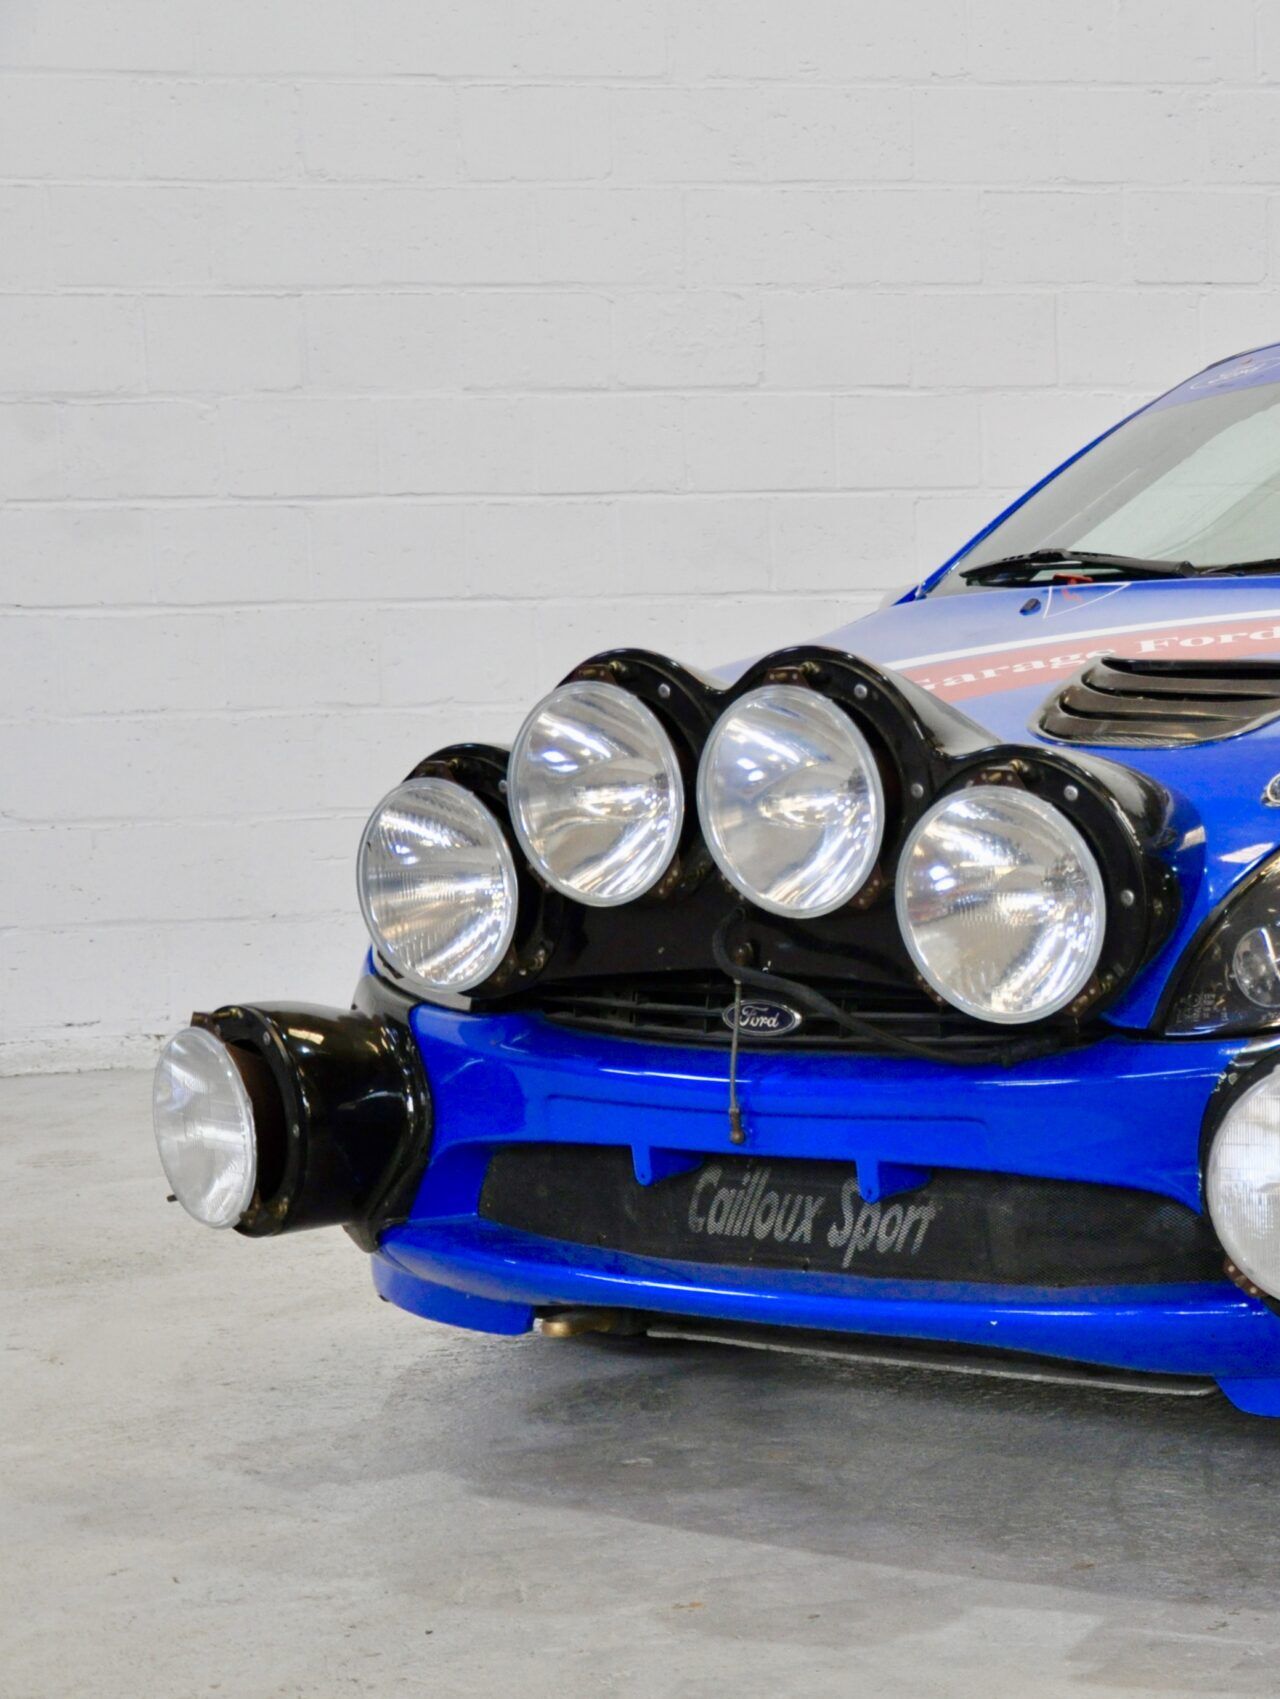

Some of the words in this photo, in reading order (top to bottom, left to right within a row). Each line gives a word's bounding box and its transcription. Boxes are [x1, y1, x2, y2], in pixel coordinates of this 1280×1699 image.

[738, 1005, 780, 1028] Ford
[688, 1165, 825, 1244] Cailloux
[827, 1176, 937, 1269] Sport
